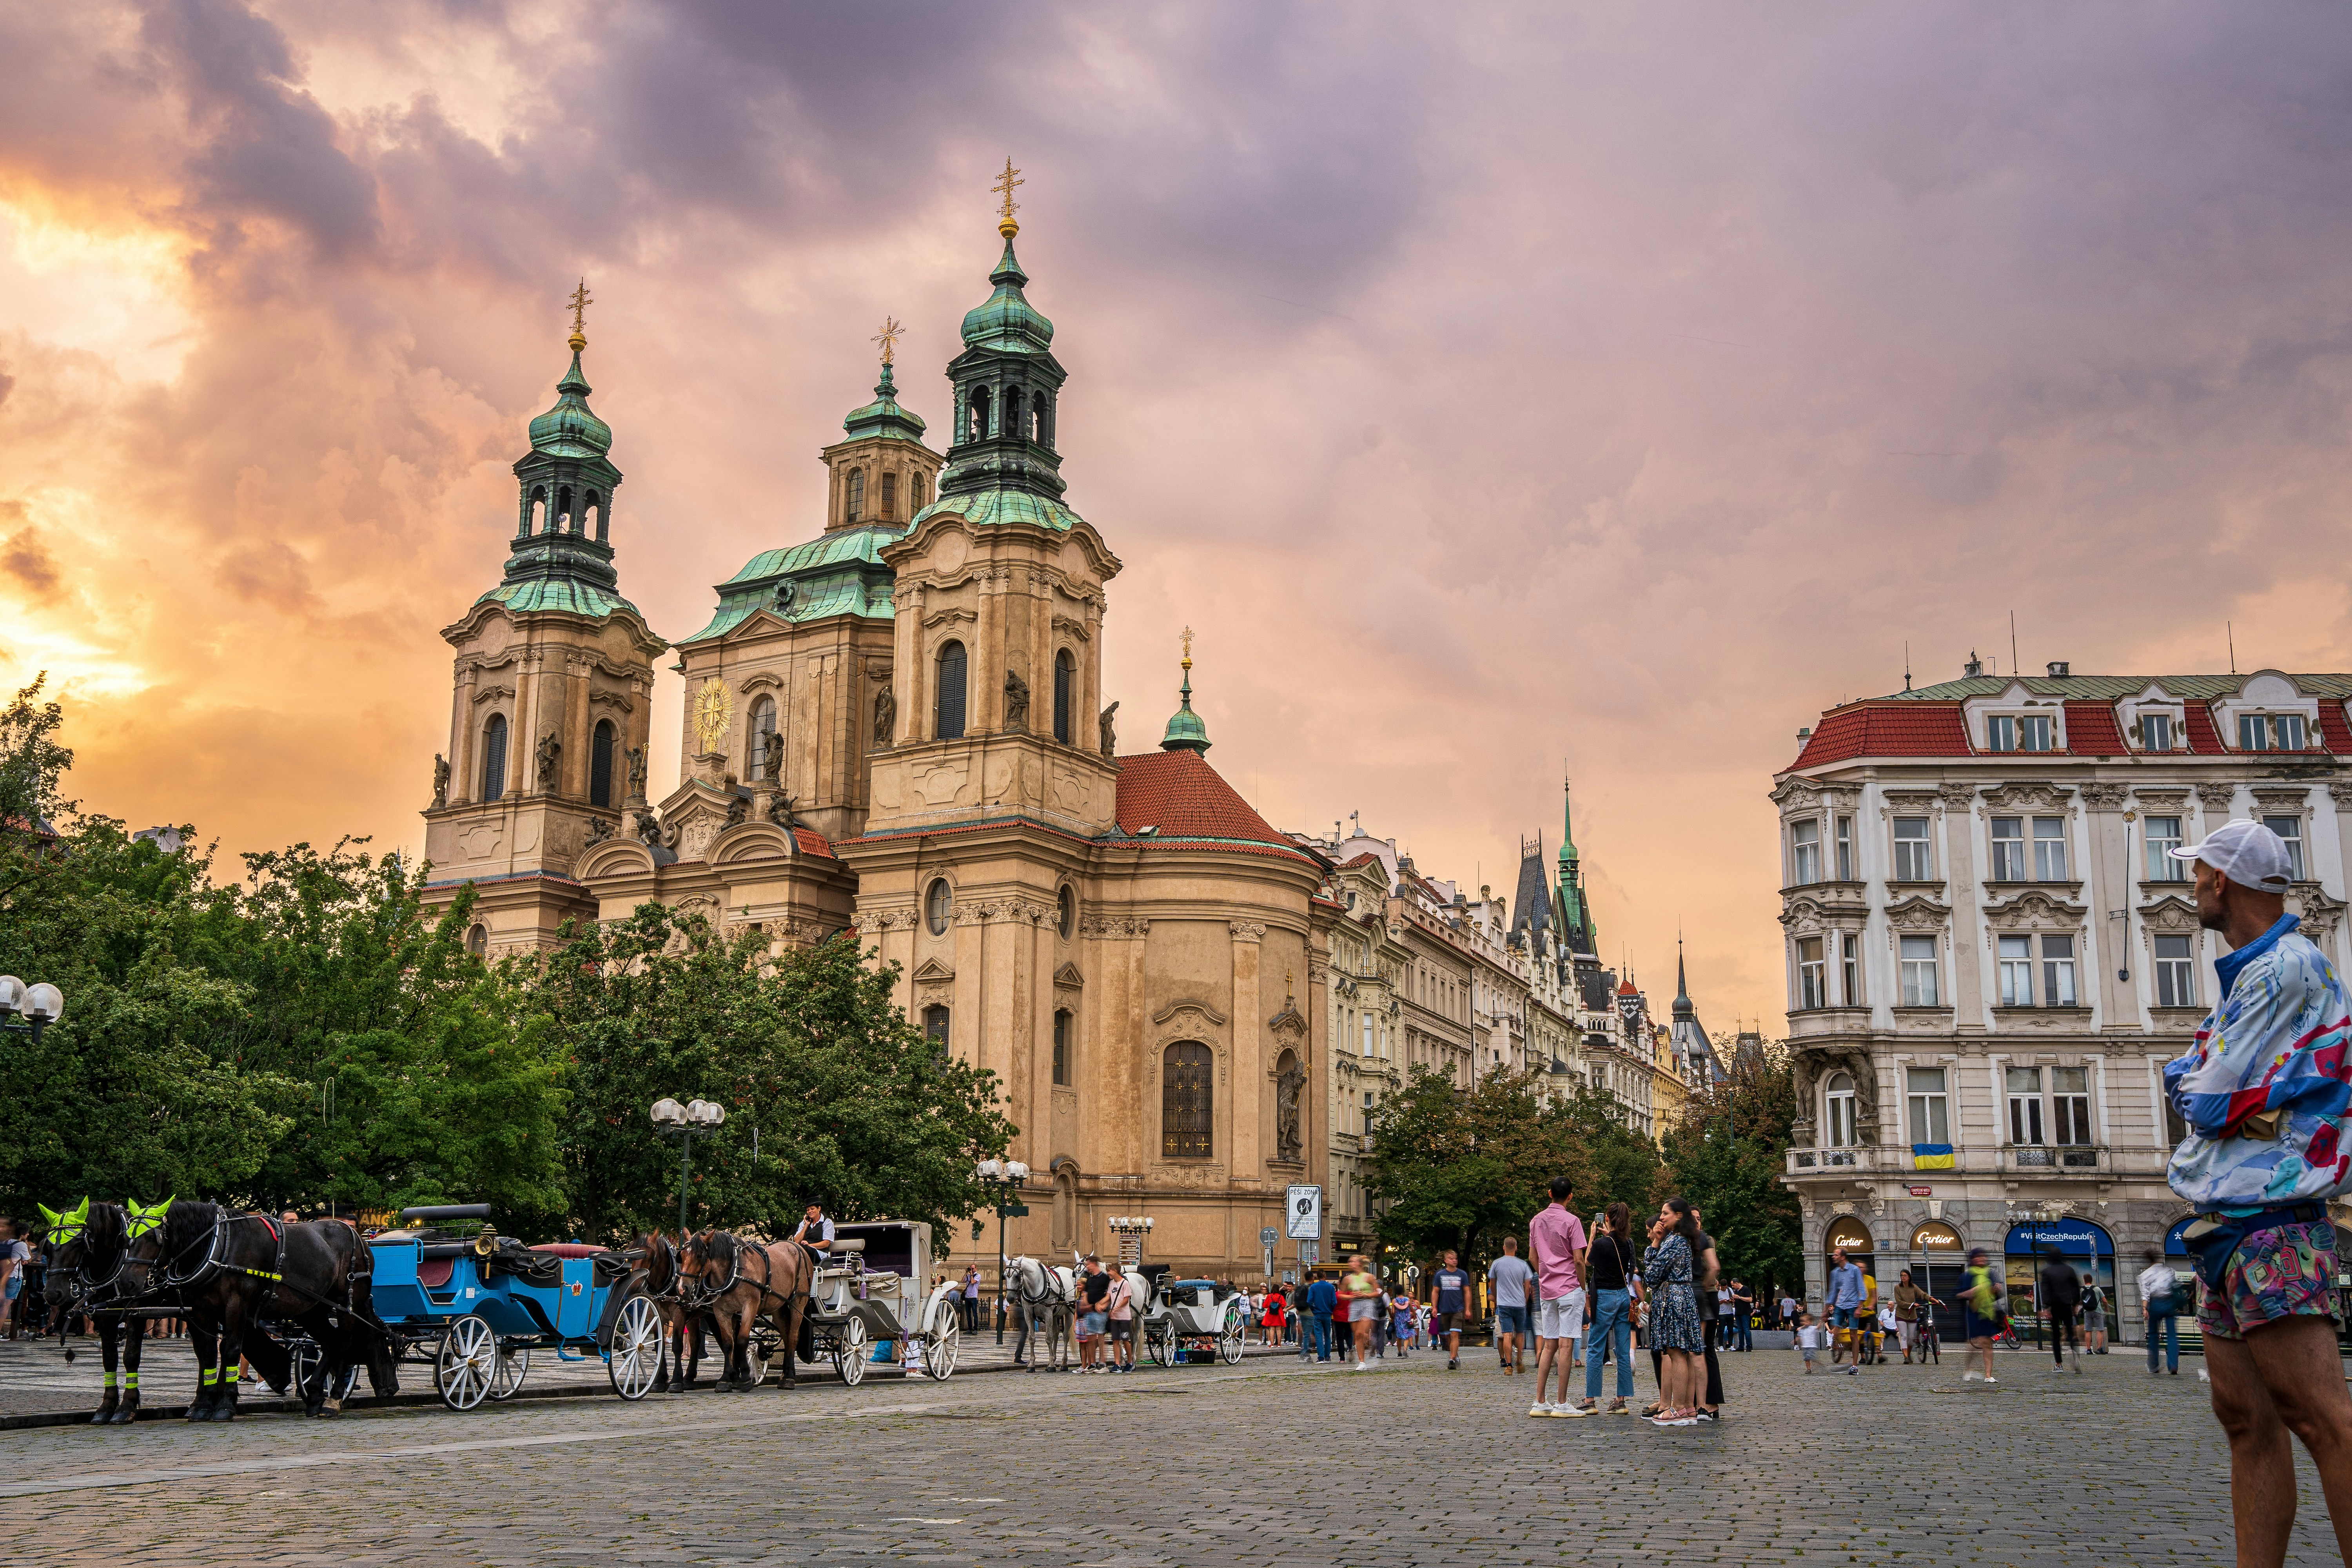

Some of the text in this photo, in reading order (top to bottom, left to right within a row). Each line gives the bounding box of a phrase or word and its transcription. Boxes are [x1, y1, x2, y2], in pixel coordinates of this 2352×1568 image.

[1835, 1235, 1864, 1246] Cartier
[1917, 1232, 1954, 1243] Cartier
[2021, 1232, 2095, 1241] #ViitCzechRepubl
